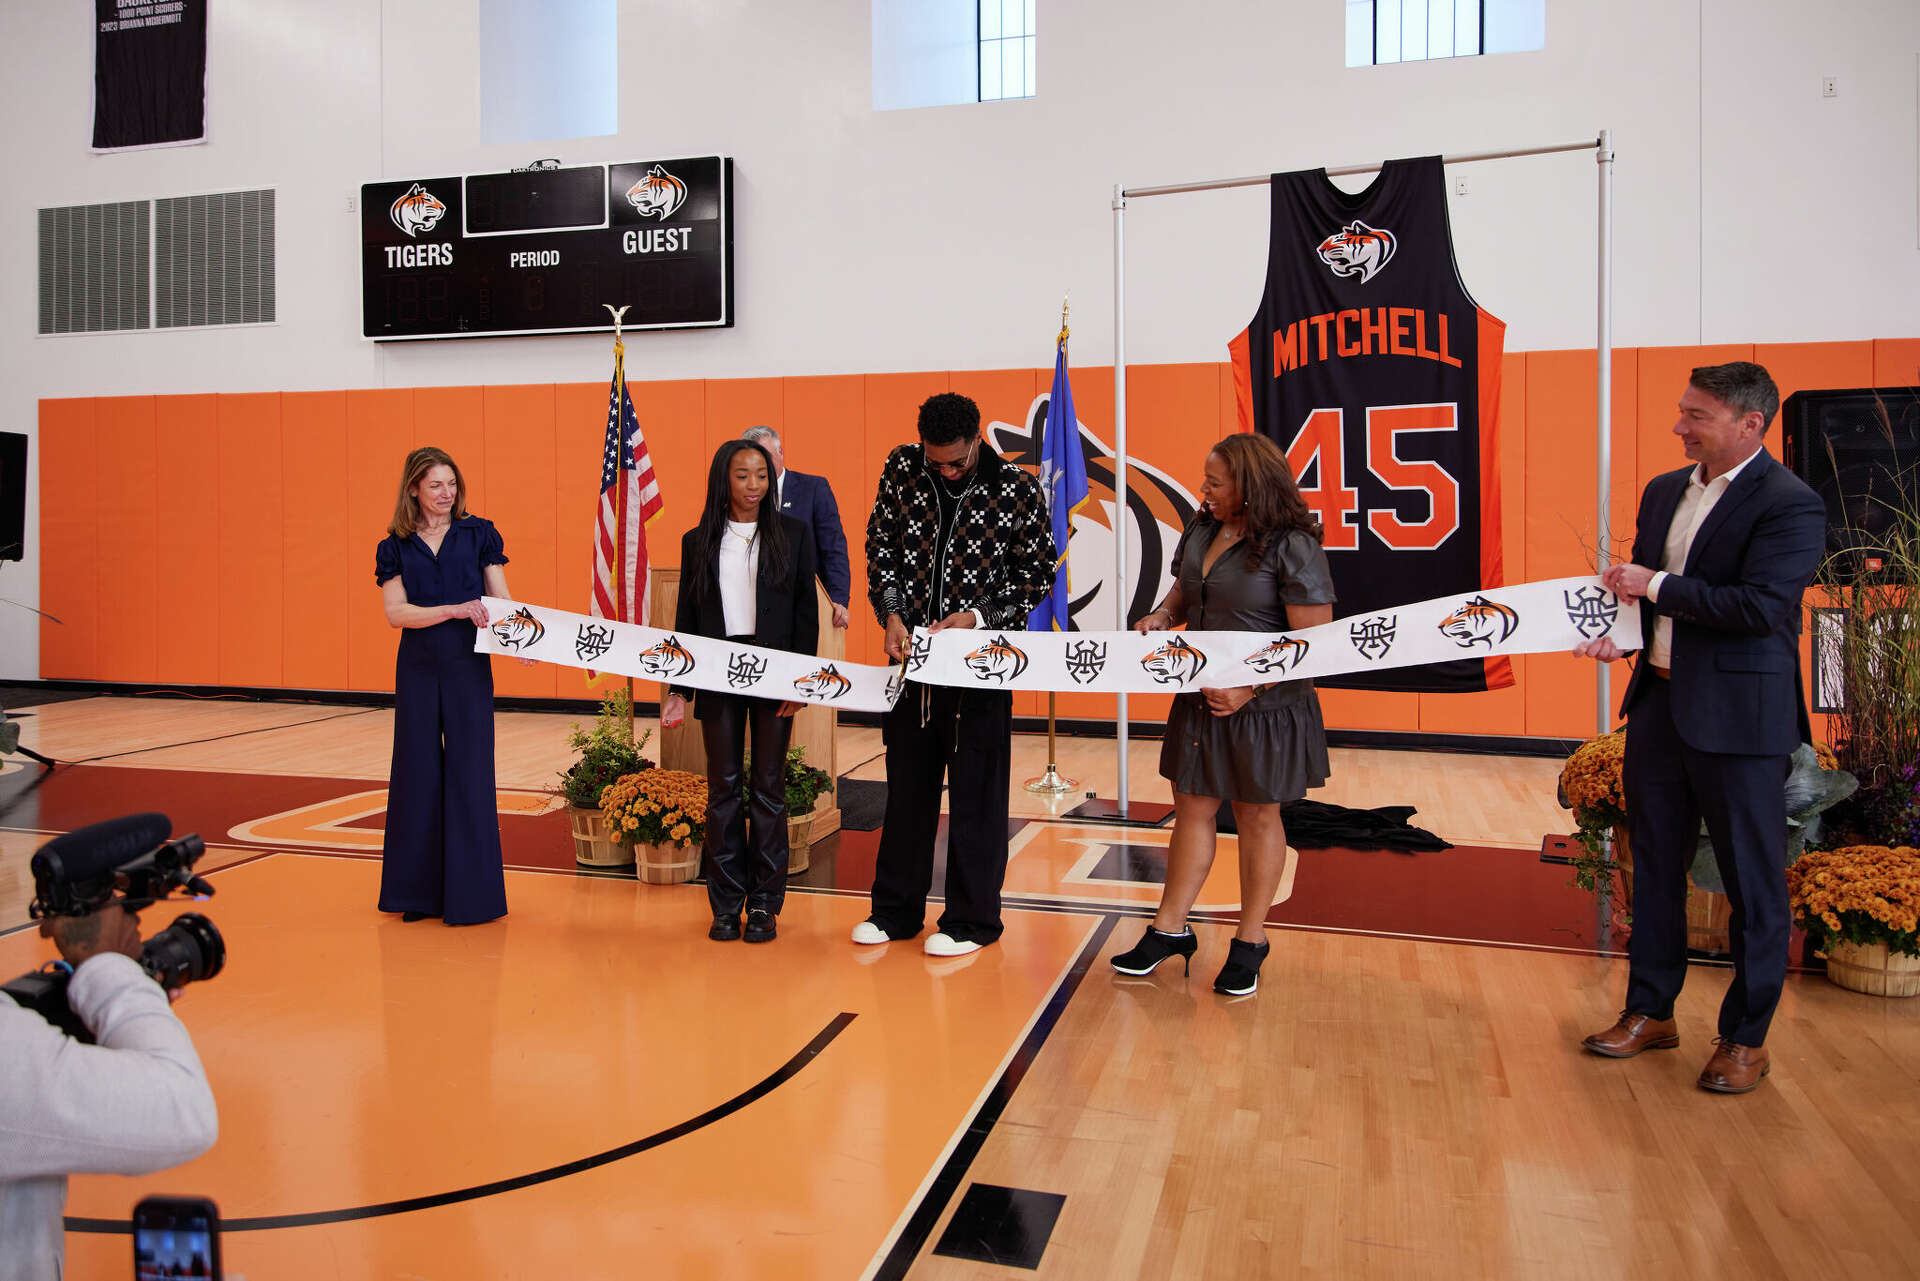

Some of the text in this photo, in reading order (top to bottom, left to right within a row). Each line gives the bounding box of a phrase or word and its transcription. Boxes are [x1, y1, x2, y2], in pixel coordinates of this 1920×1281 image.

[136, 6, 154, 17] POINT
[155, 1, 184, 14] SCORERS
[100, 21, 118, 32] 2023
[622, 227, 693, 254] GUEST
[384, 242, 454, 268] TIGERS
[510, 250, 560, 268] PERIOD
[1272, 307, 1463, 379] MITCHELL
[1284, 402, 1460, 551] 45
